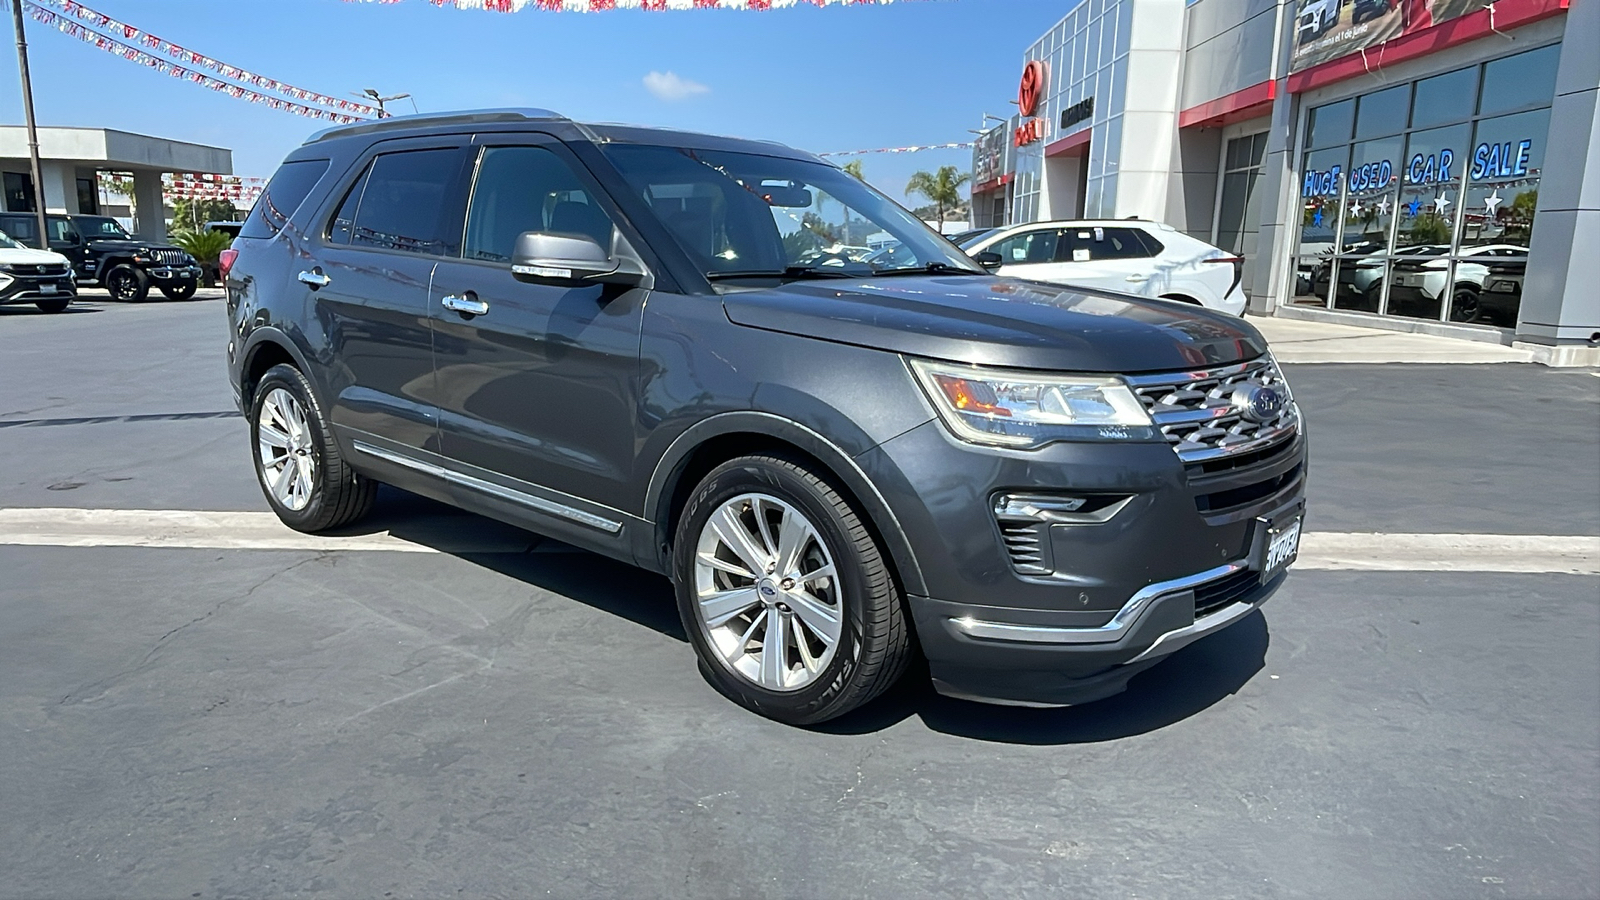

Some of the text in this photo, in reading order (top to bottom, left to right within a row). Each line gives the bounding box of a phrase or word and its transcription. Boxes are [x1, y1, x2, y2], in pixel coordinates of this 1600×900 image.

[1302, 139, 1532, 197] HUGE USED CAR SALE
